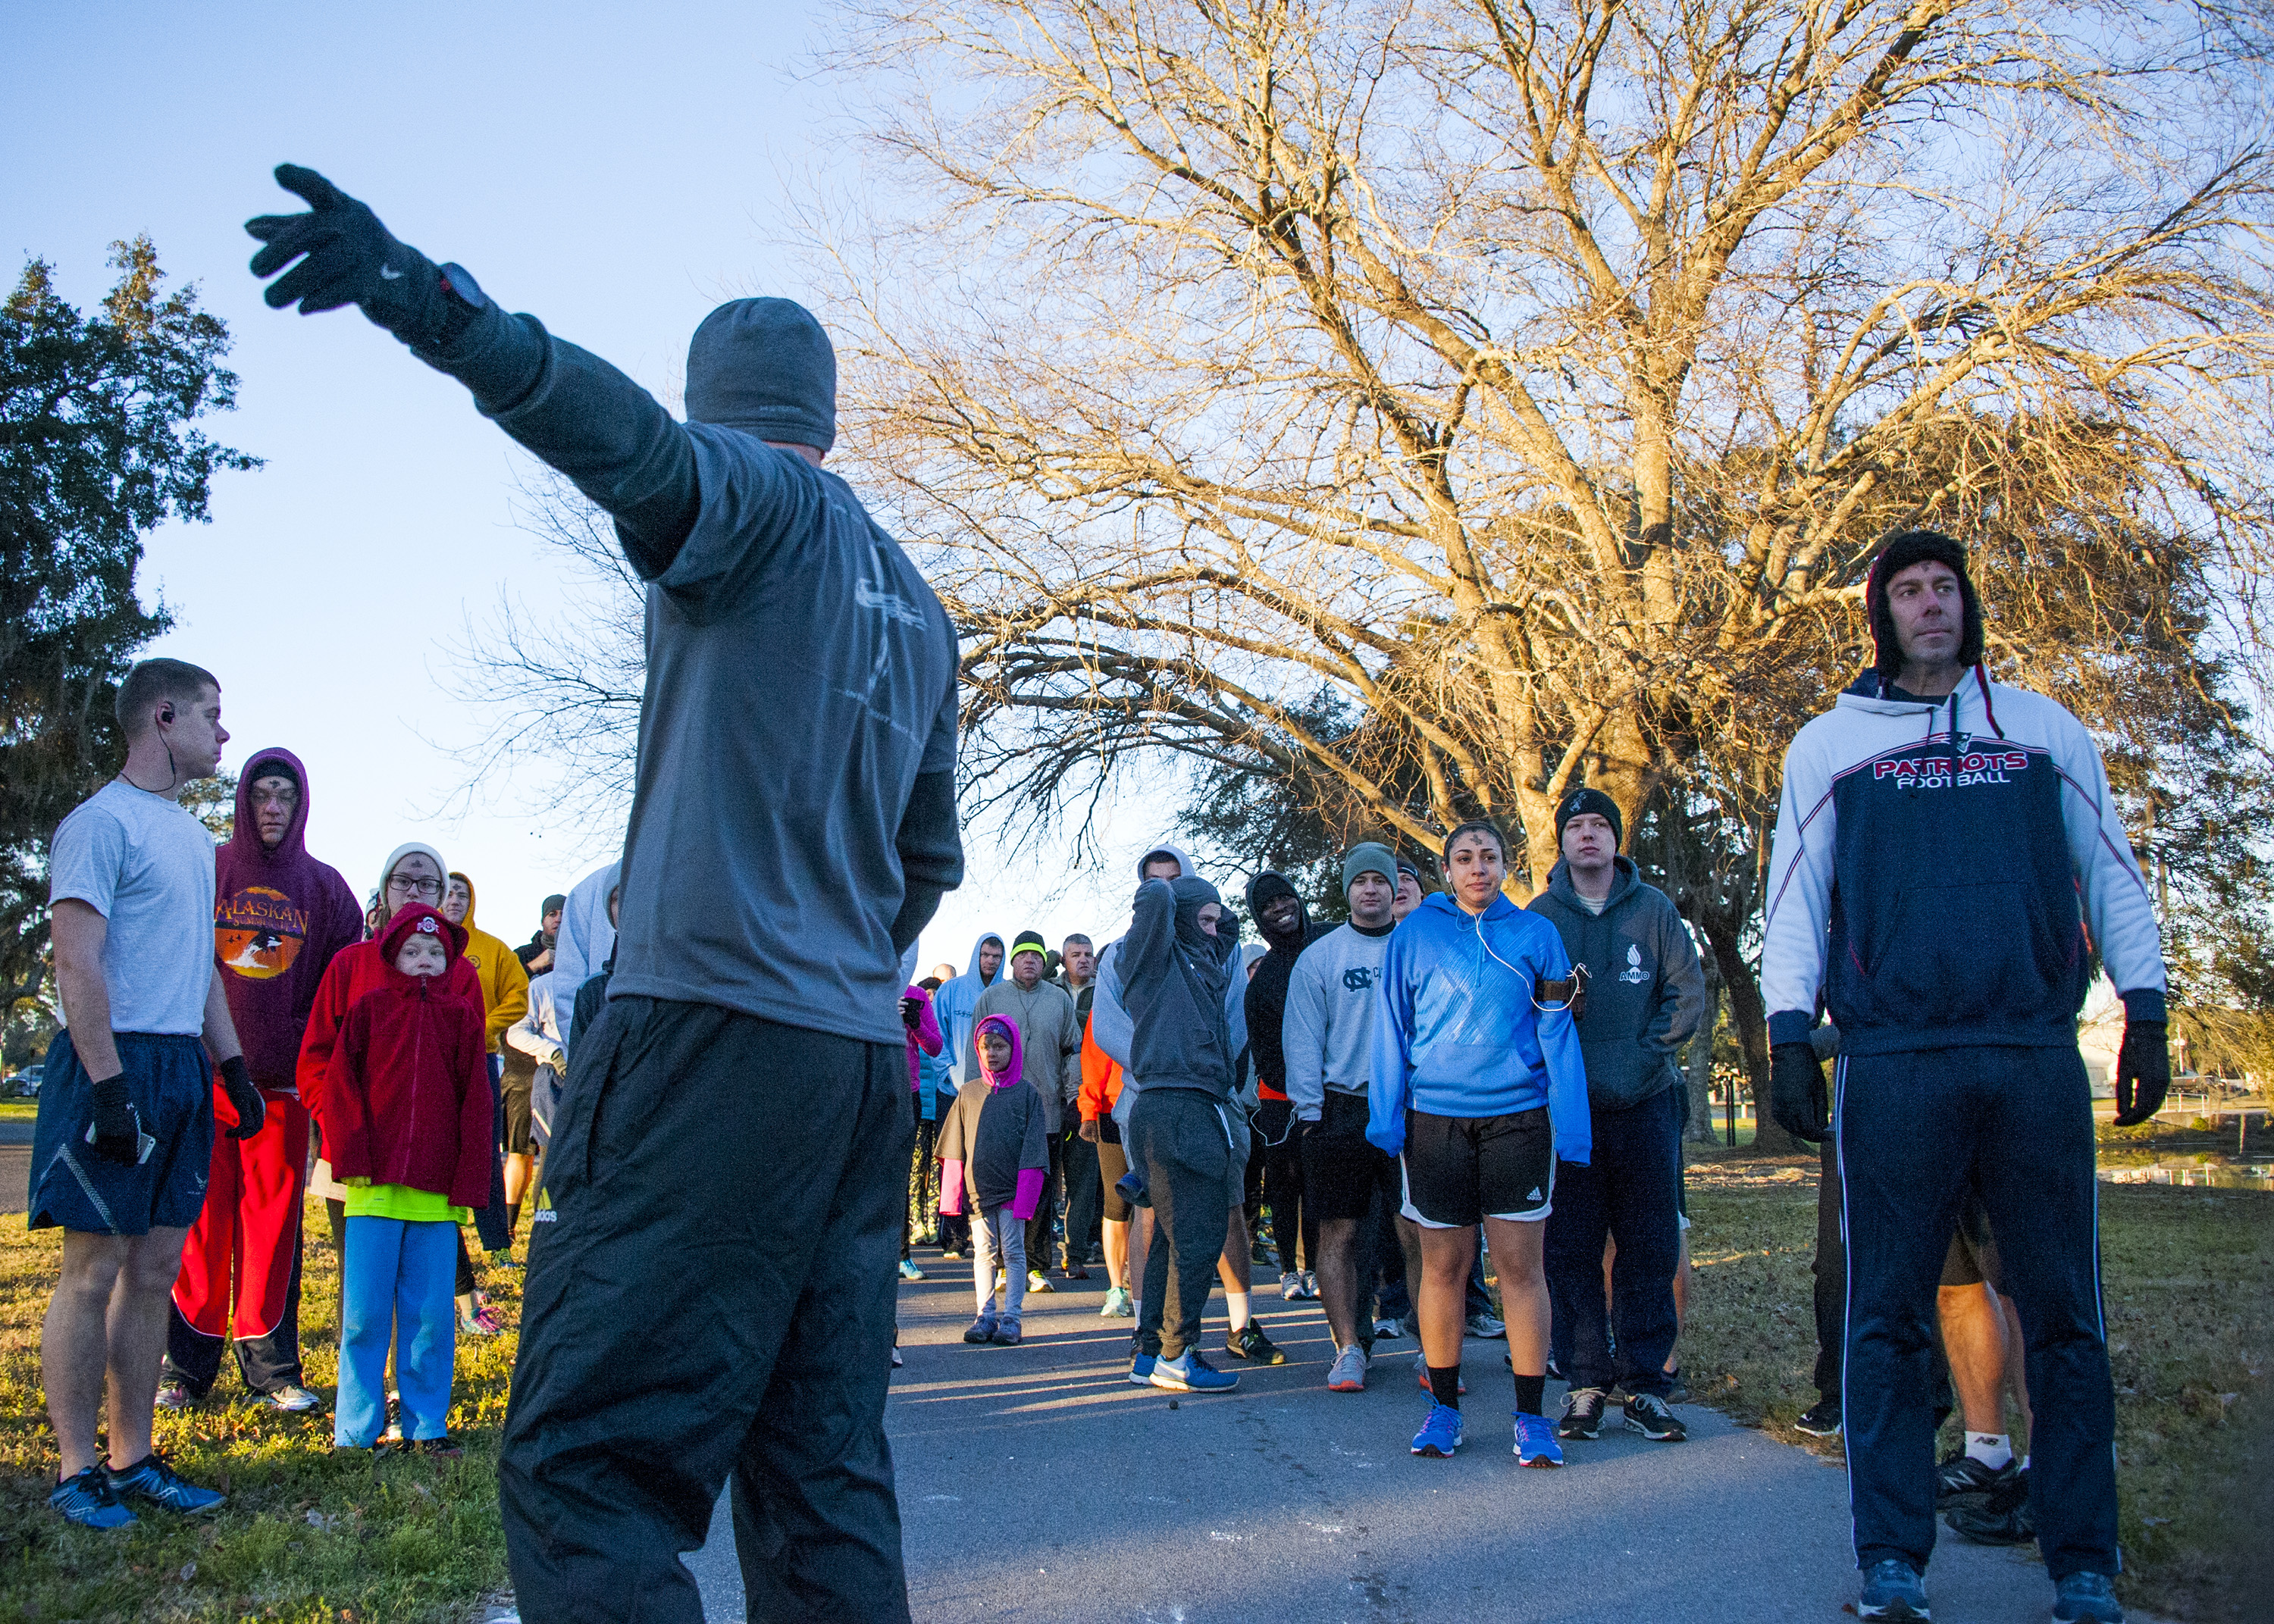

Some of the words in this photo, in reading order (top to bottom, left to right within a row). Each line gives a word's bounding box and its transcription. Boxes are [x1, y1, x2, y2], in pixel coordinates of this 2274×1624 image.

[1874, 751, 2028, 780] PATRIOTS
[1897, 771, 2011, 790] FOOTBALL
[214, 900, 309, 936] ALASKAN
[1619, 971, 1650, 981] AMMO
